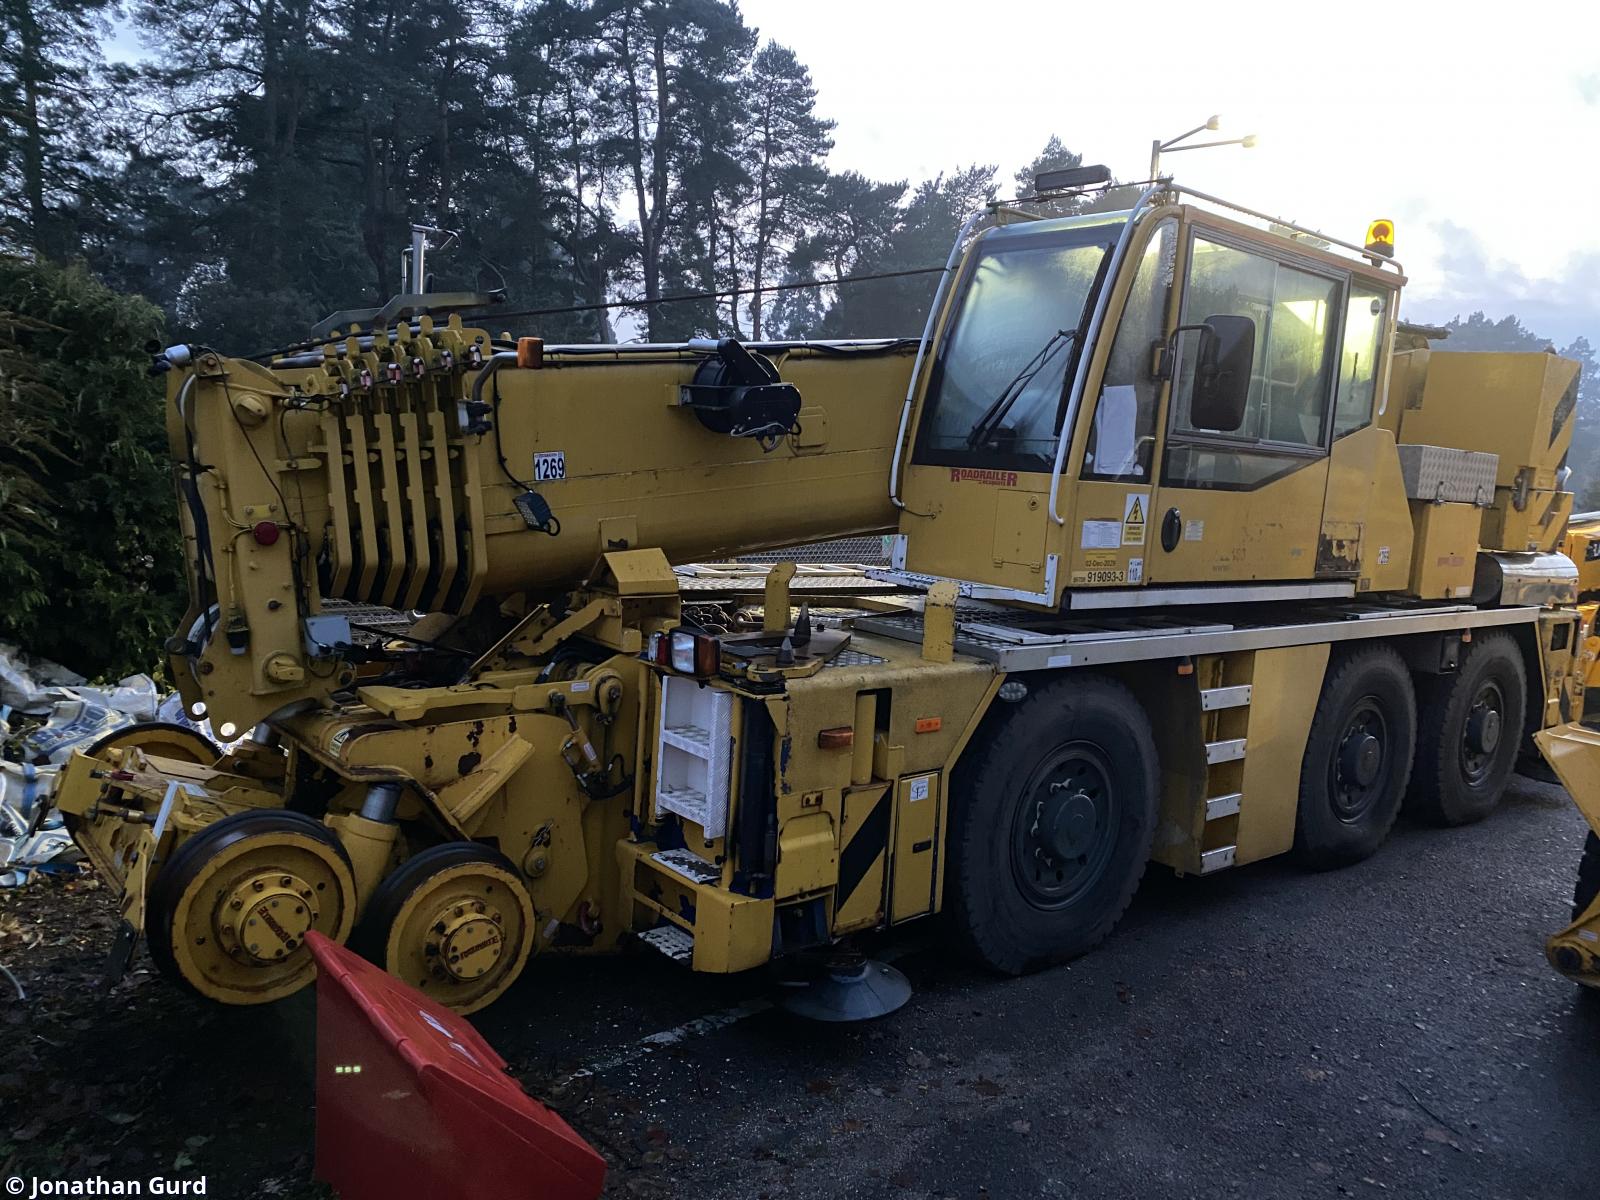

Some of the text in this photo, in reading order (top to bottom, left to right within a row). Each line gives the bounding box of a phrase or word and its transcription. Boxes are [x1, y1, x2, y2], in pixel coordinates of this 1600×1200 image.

[535, 458, 565, 480] 1269
[951, 468, 1018, 486] ROADRAILER
[1087, 571, 1124, 583] 919093-3
